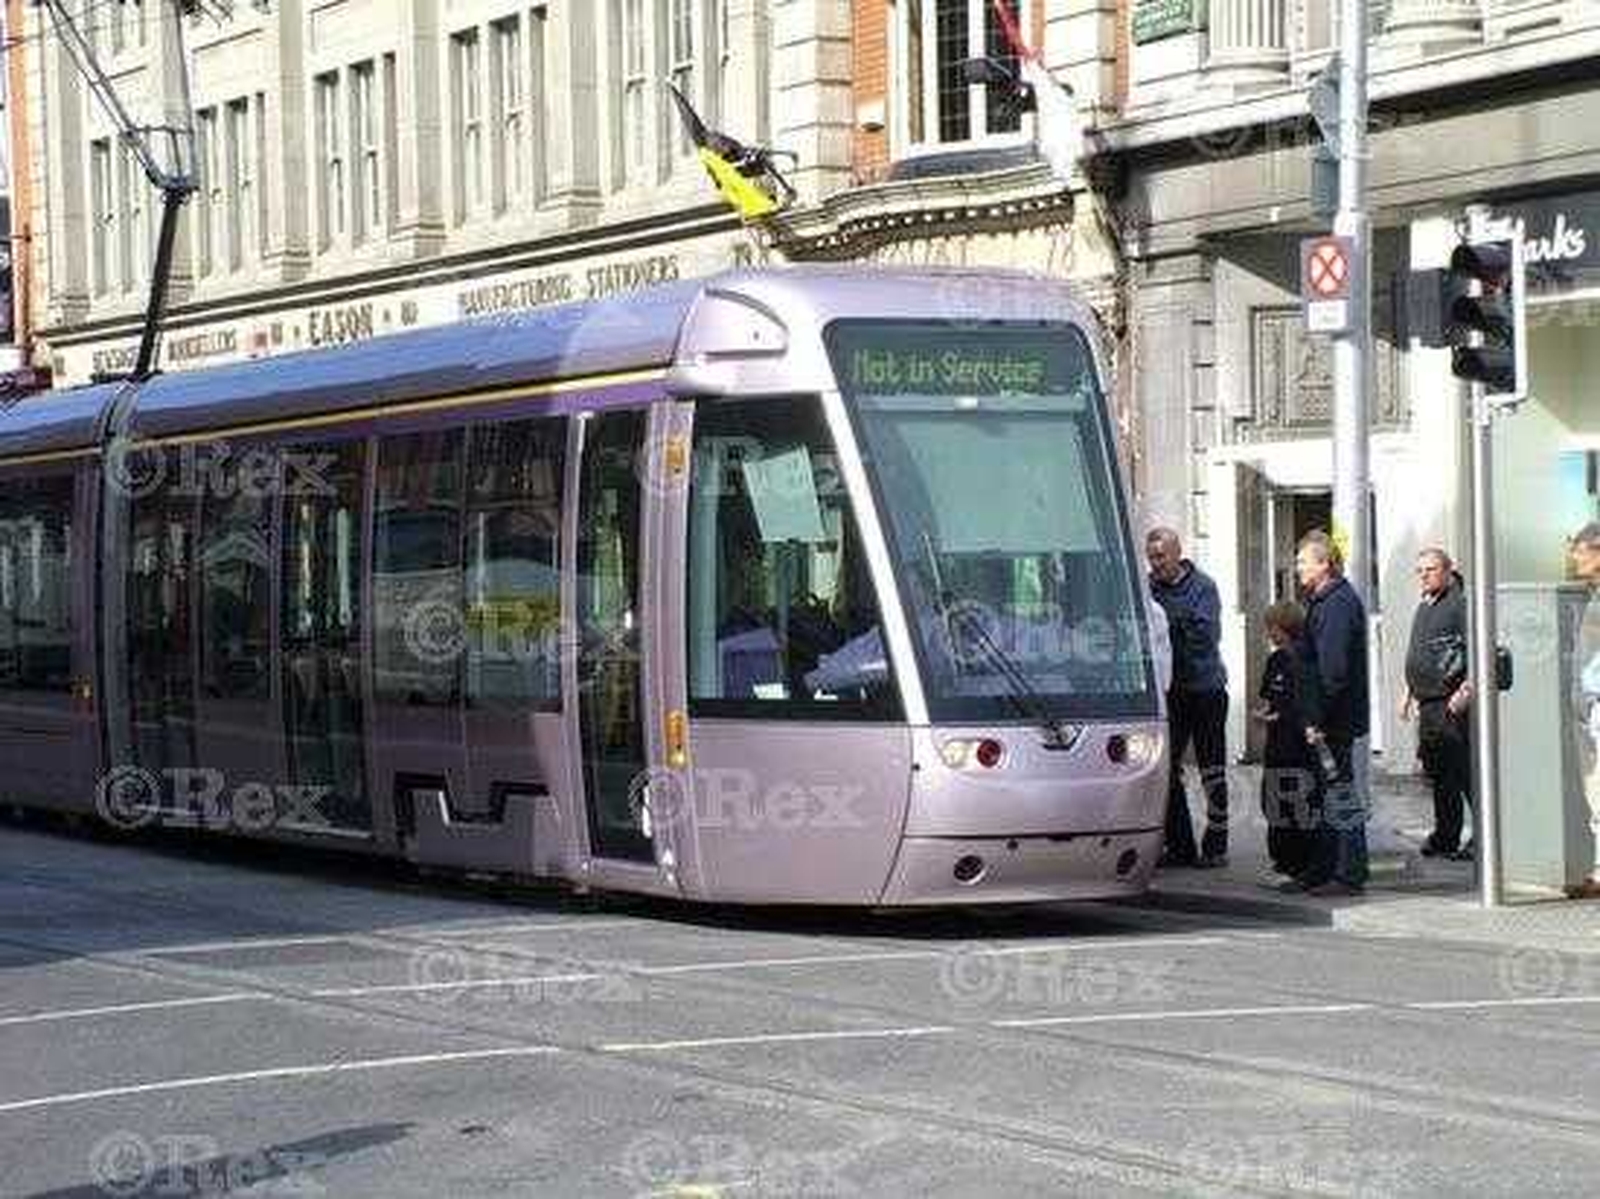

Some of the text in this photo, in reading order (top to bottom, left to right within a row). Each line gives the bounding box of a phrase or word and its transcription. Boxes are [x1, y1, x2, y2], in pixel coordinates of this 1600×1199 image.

[309, 302, 373, 346] EASON
[853, 349, 1046, 388] Not in Service
